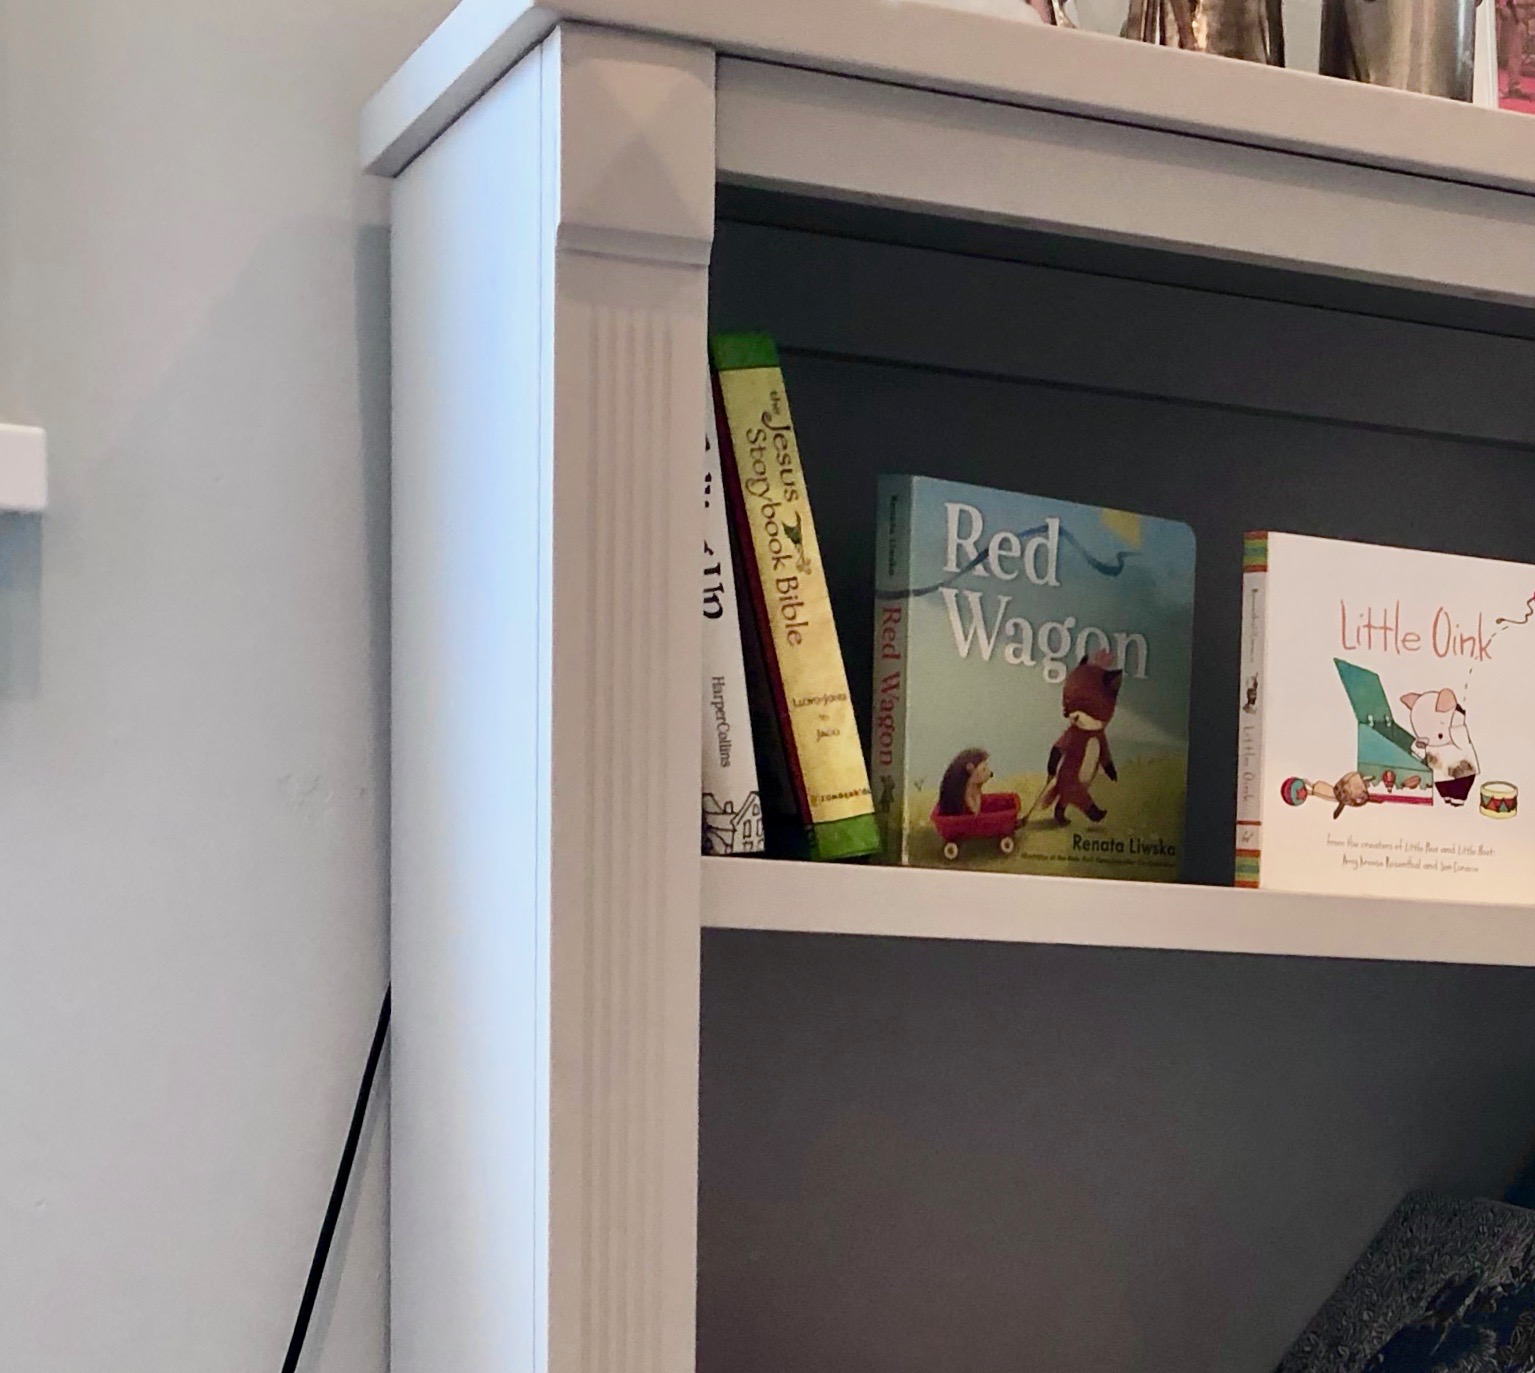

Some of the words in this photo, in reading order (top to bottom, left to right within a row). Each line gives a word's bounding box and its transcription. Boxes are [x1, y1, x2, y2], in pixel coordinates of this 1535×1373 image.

[761, 410, 798, 502] Jesus
[745, 428, 792, 571] Storybook
[775, 575, 809, 647] Bible
[943, 502, 1061, 587] Red
[881, 607, 901, 660] Red
[939, 587, 1149, 684] Wagon
[1340, 599, 1421, 655] Little
[1432, 606, 1492, 661] Oink
[711, 676, 733, 768] HarperCollins
[878, 672, 900, 766] Wagon
[1072, 833, 1125, 852] Renata
[1129, 838, 1176, 856] Liwska
